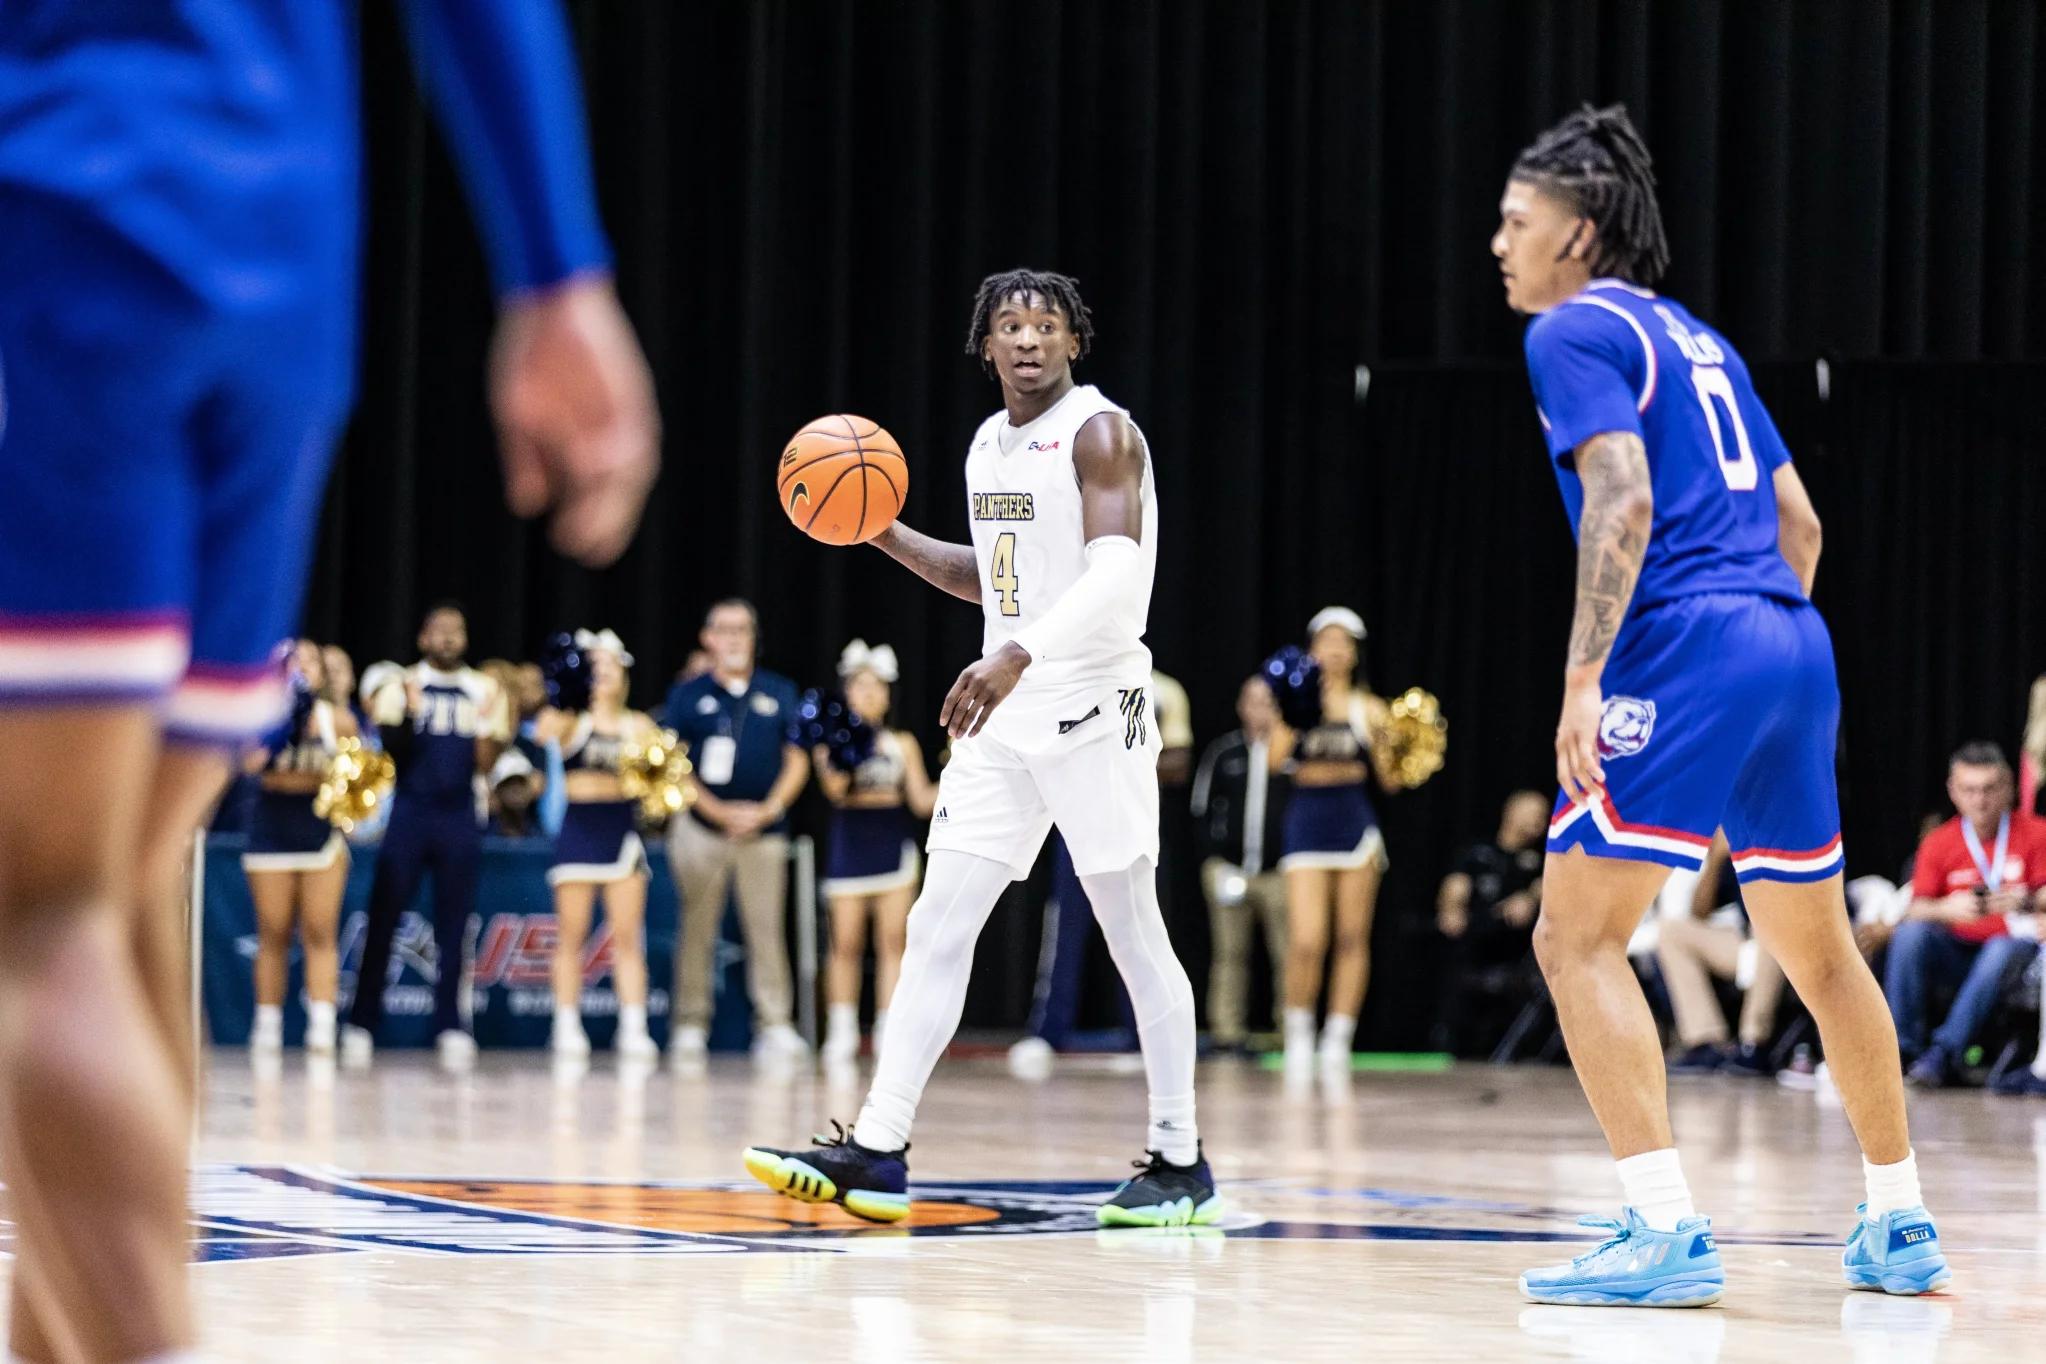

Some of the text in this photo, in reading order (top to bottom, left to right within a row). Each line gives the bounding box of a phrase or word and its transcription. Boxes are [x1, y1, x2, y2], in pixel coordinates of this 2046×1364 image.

[1691, 366, 1759, 491] 0
[972, 492, 1035, 521] PANTHERS
[991, 532, 1020, 617] 4
